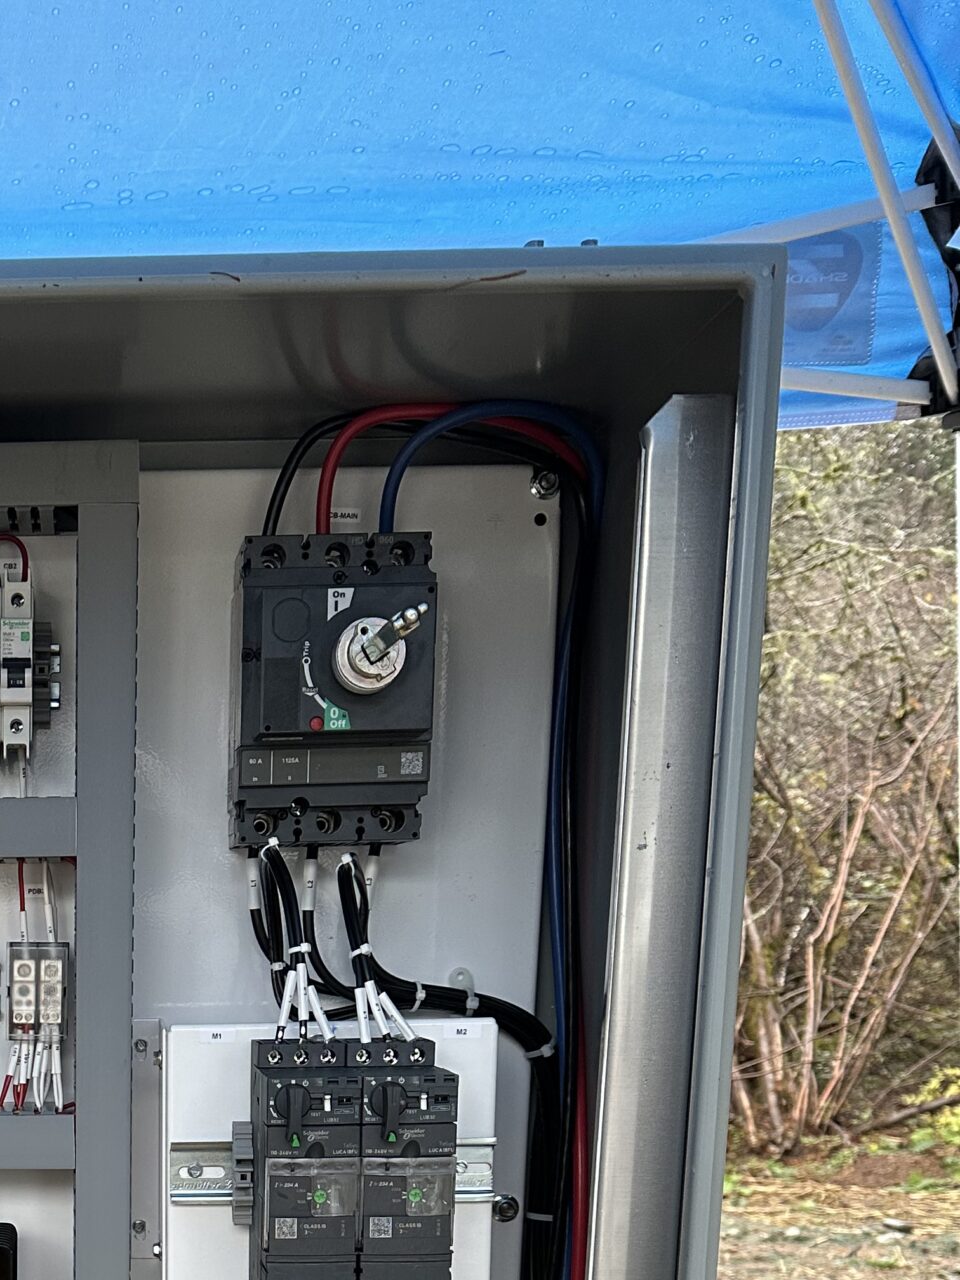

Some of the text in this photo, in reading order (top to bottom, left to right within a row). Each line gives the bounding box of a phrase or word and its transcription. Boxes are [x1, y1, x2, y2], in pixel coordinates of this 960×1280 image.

[333, 590, 346, 599] On
[2, 620, 30, 630] Schneider
[302, 641, 310, 656] Trip
[330, 719, 347, 729] Off
[250, 879, 257, 888] L1
[306, 880, 314, 889] L2
